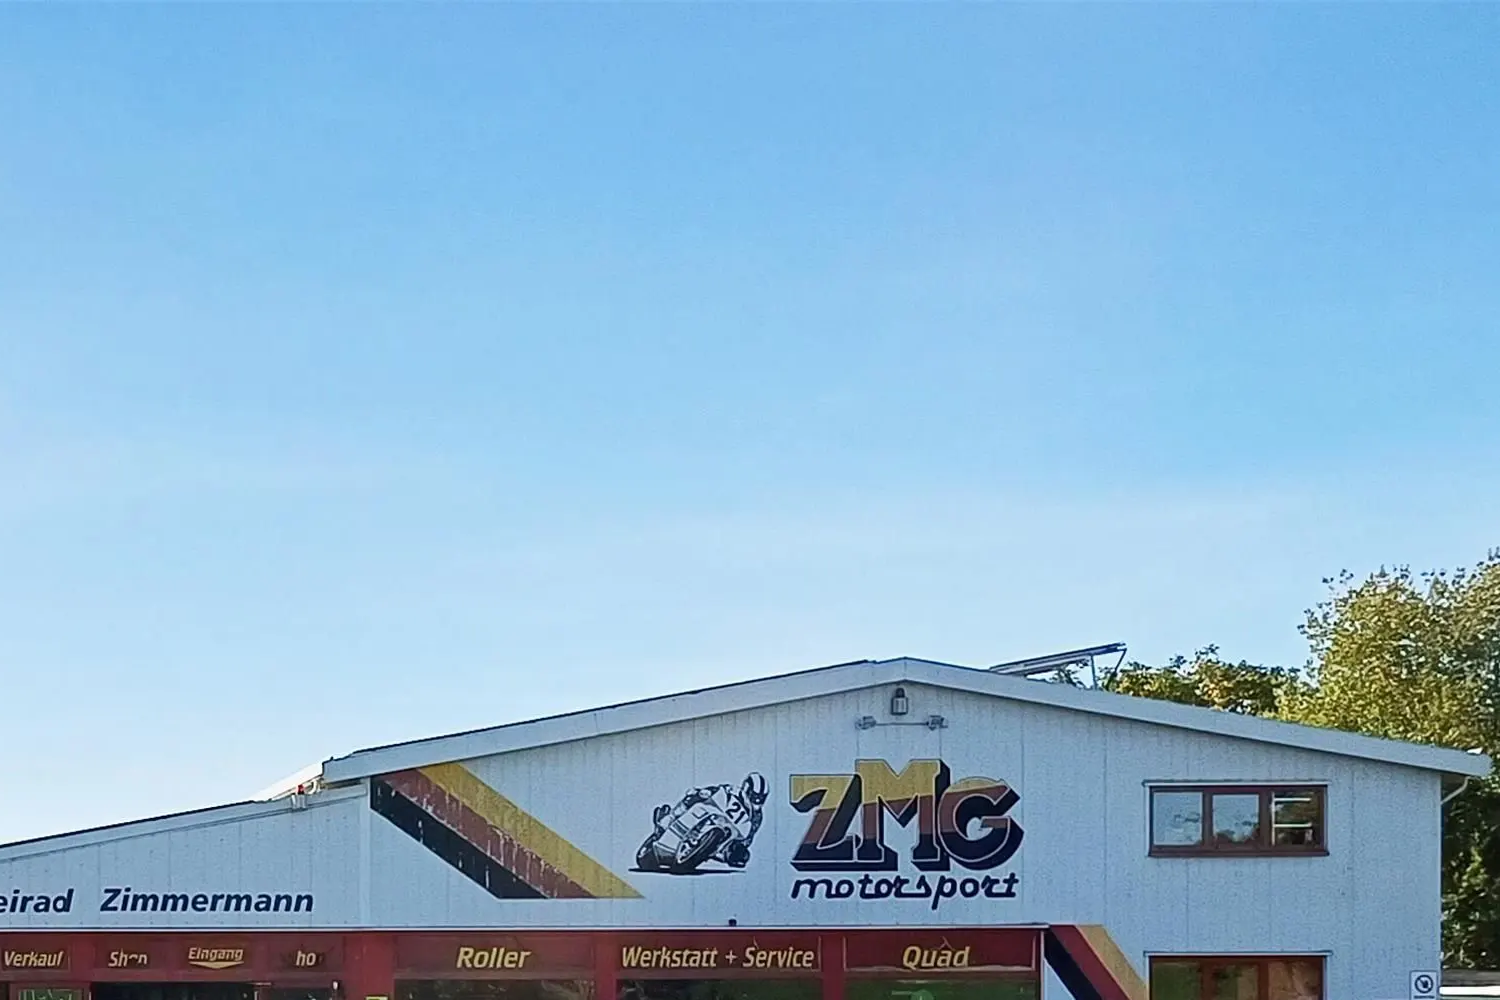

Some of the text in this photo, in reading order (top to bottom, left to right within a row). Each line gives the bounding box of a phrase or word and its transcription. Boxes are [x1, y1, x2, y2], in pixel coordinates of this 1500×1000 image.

[726, 802, 746, 825] 21
[790, 758, 1024, 872] ZMG
[99, 887, 314, 913] Zimmermann
[791, 872, 1019, 910] motorsport
[3, 950, 63, 967] Verkauf
[188, 947, 244, 962] Eingang
[456, 946, 531, 969] Roller
[621, 946, 718, 968] Werkstatt
[743, 946, 815, 968] Service
[902, 946, 970, 969] Quad
